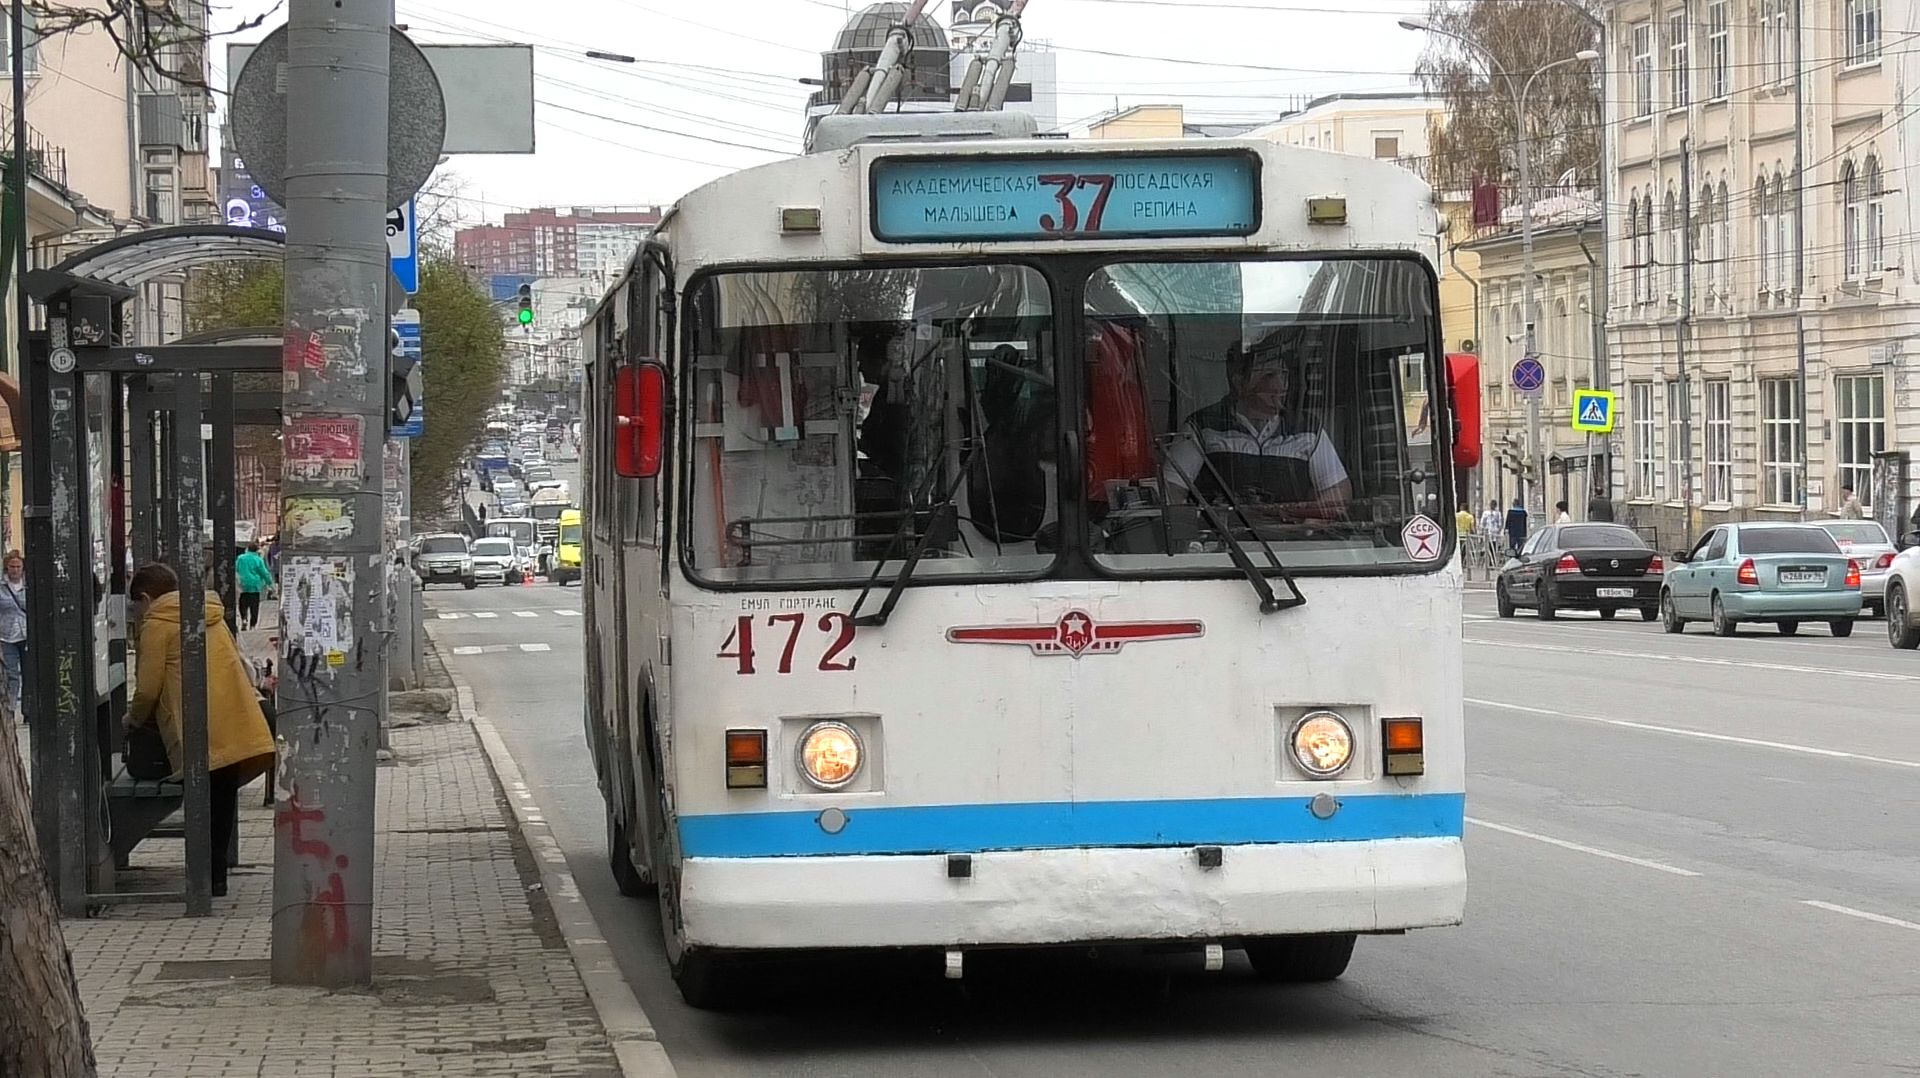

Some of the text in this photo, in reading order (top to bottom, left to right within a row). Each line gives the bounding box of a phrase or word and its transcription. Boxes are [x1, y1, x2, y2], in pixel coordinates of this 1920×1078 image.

[891, 175, 1038, 195] АКАДЕМИЧЕСКАЯ
[1114, 172, 1213, 190] ПОСАДСКАЯ
[1037, 173, 1115, 231] 37
[1133, 201, 1198, 218] РЕПИНА
[924, 205, 1018, 223] МАЛЫШЕВА
[741, 597, 836, 610] ЕМУП ГОРТРАНС
[716, 611, 857, 675] 472
